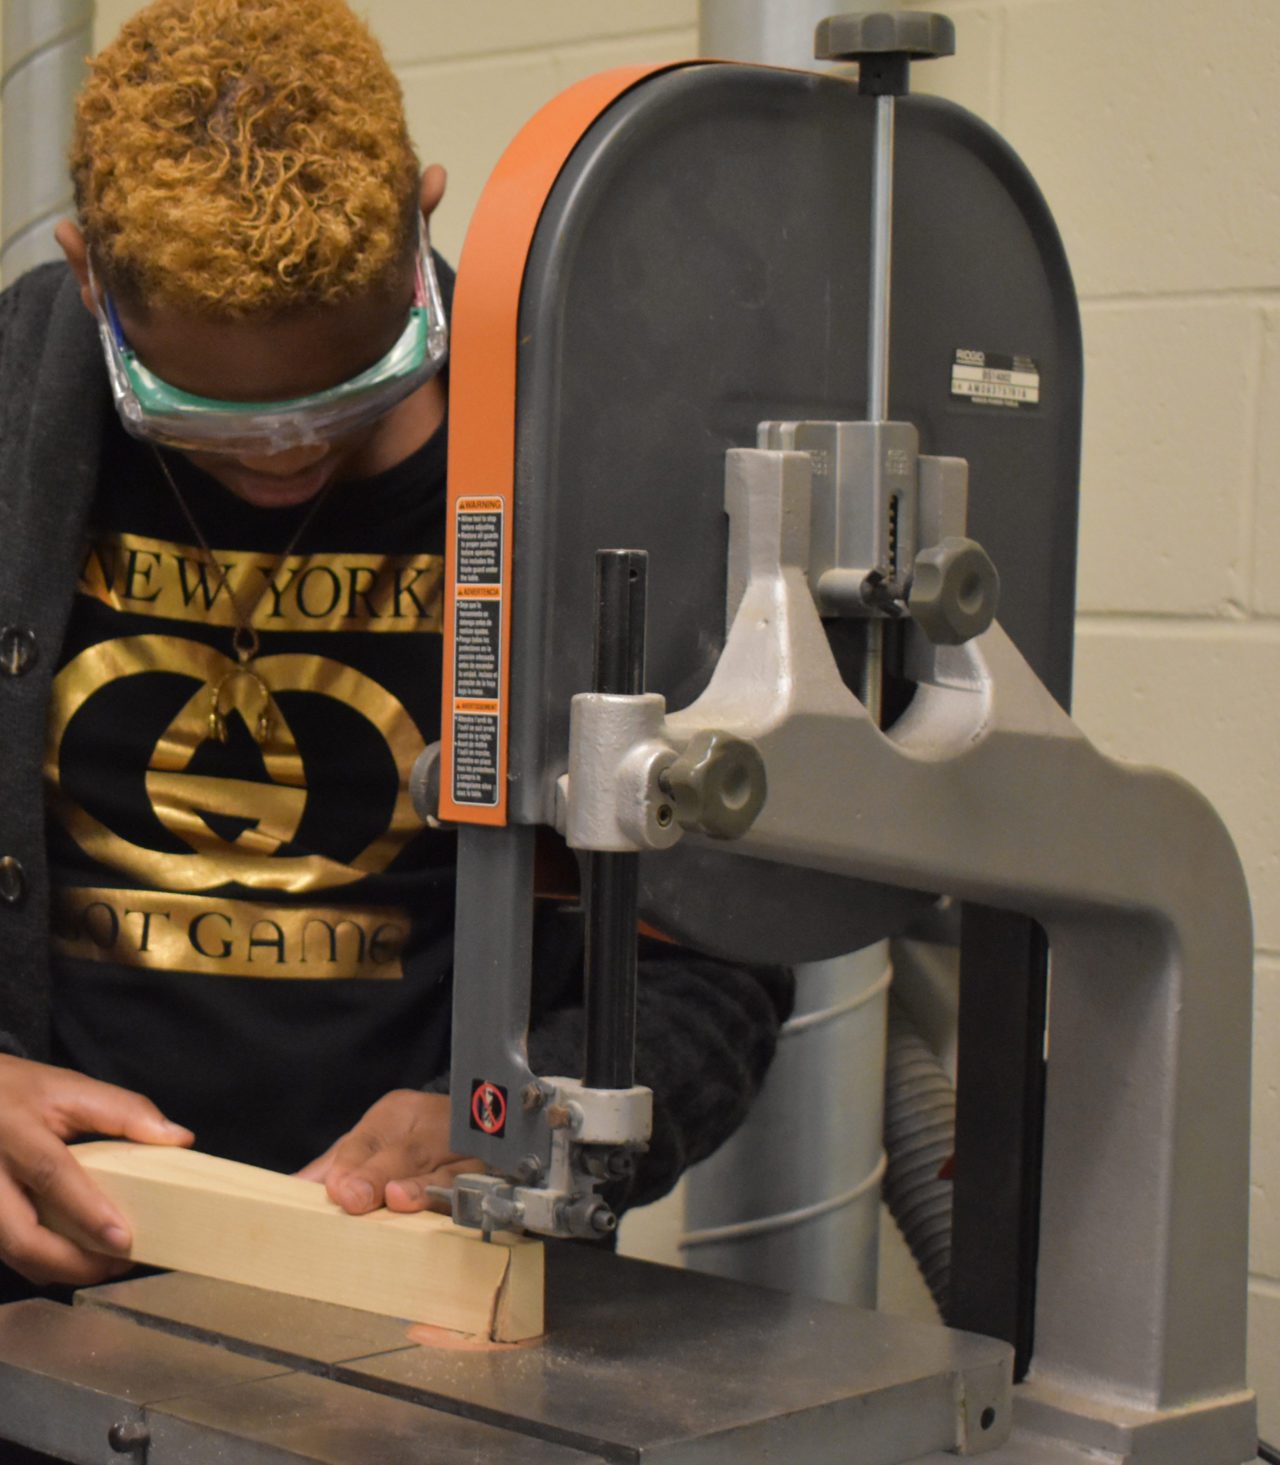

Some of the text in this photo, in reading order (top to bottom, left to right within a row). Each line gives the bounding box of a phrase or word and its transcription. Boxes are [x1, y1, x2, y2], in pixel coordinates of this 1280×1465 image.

[465, 499, 502, 510] WARNING
[80, 545, 433, 618] NEW YORK
[54, 902, 171, 952] OT
